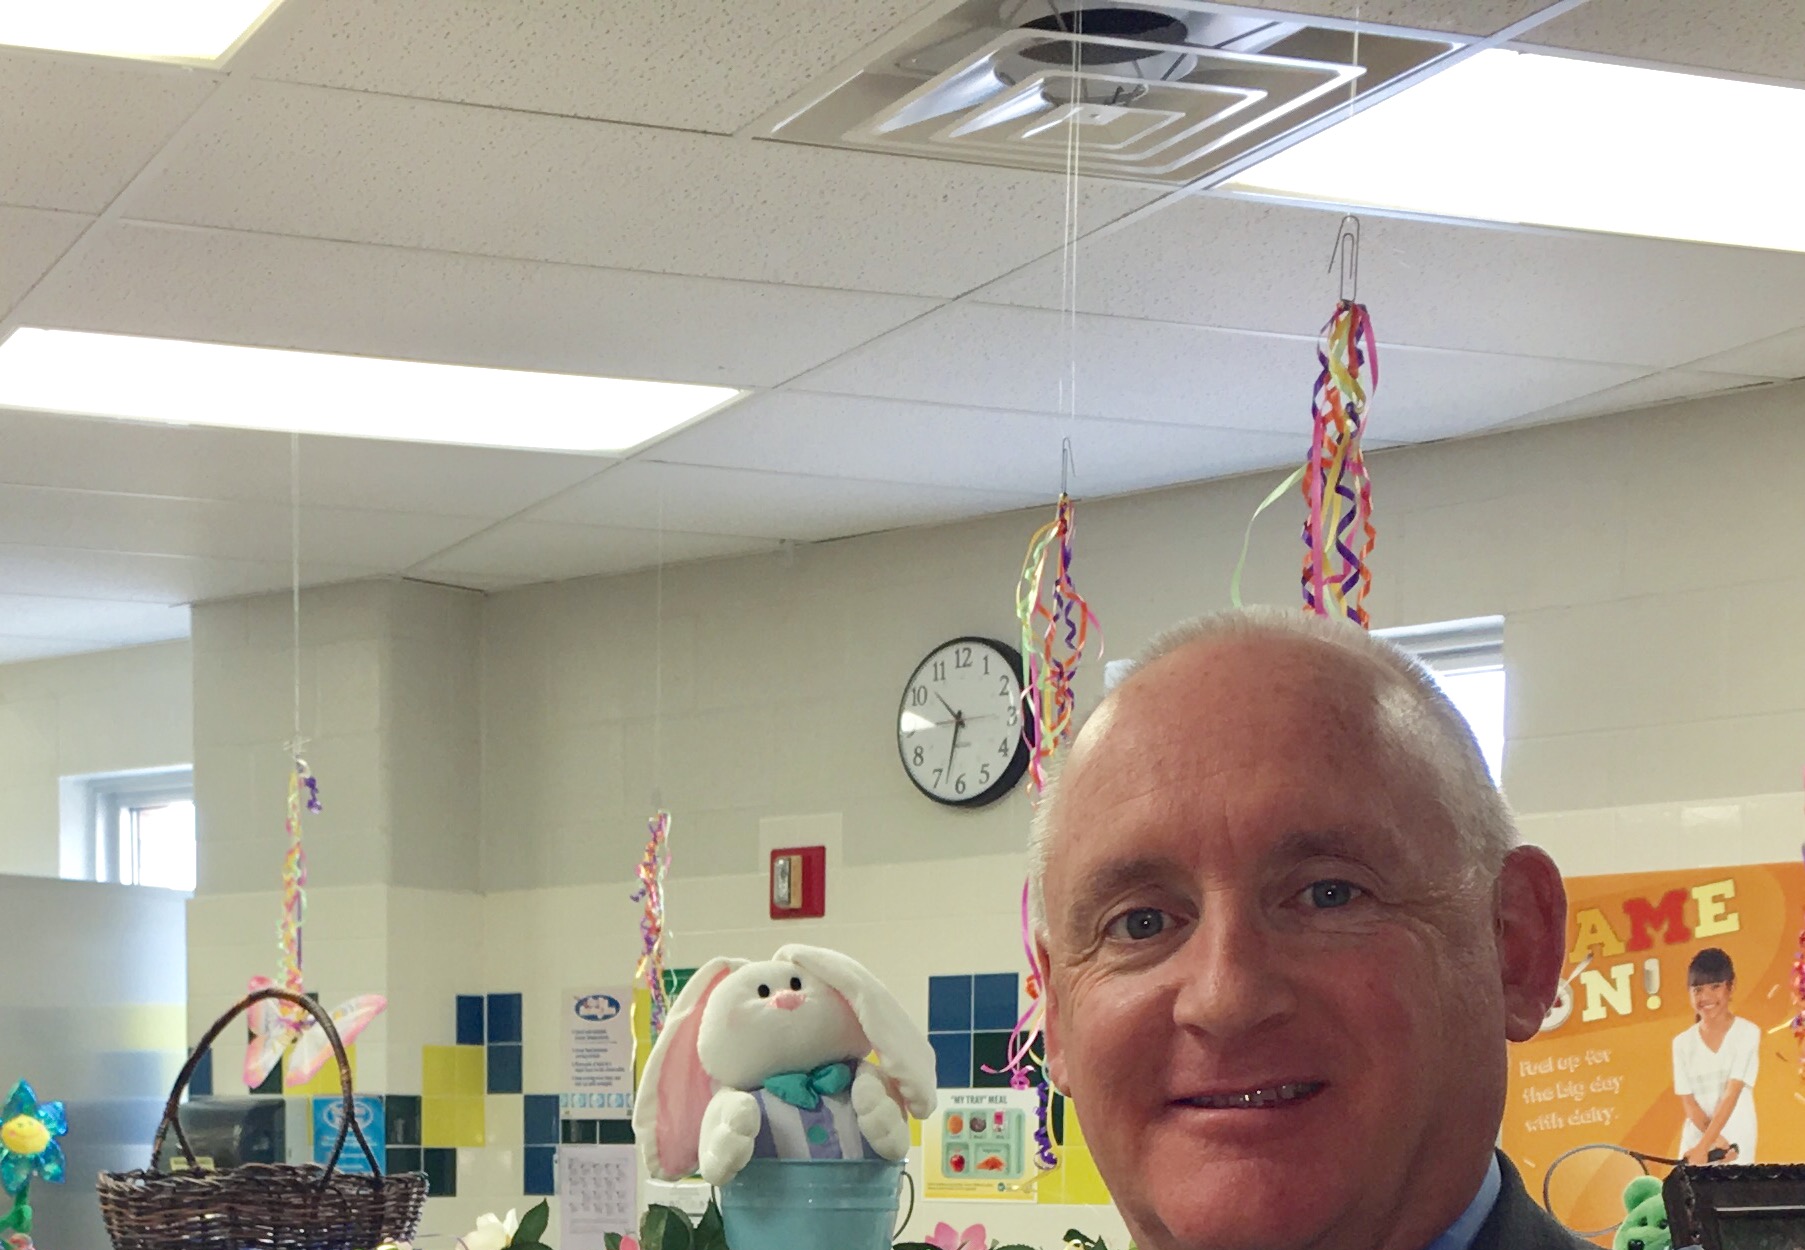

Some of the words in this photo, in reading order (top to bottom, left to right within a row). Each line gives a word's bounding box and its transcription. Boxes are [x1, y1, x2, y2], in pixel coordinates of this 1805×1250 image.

[954, 647, 973, 669] 12
[982, 654, 990, 675] 1
[932, 660, 946, 682] 11
[911, 685, 928, 707] 10
[999, 674, 1010, 696] 2
[1006, 705, 1018, 727] 3
[912, 745, 924, 767] 8
[998, 737, 1009, 757] 4
[932, 768, 943, 789] 7
[954, 773, 966, 795] 6
[978, 763, 990, 785] 5
[1568, 878, 1740, 964] AME
[1519, 1056, 1554, 1077] Fuel
[1557, 1055, 1581, 1073] up
[1584, 1048, 1611, 1066] for
[988, 1095, 1008, 1104] MEAL
[1522, 1086, 1554, 1104] the
[1556, 1080, 1585, 1101] big
[1589, 1075, 1623, 1095] day
[1524, 1111, 1564, 1133] with
